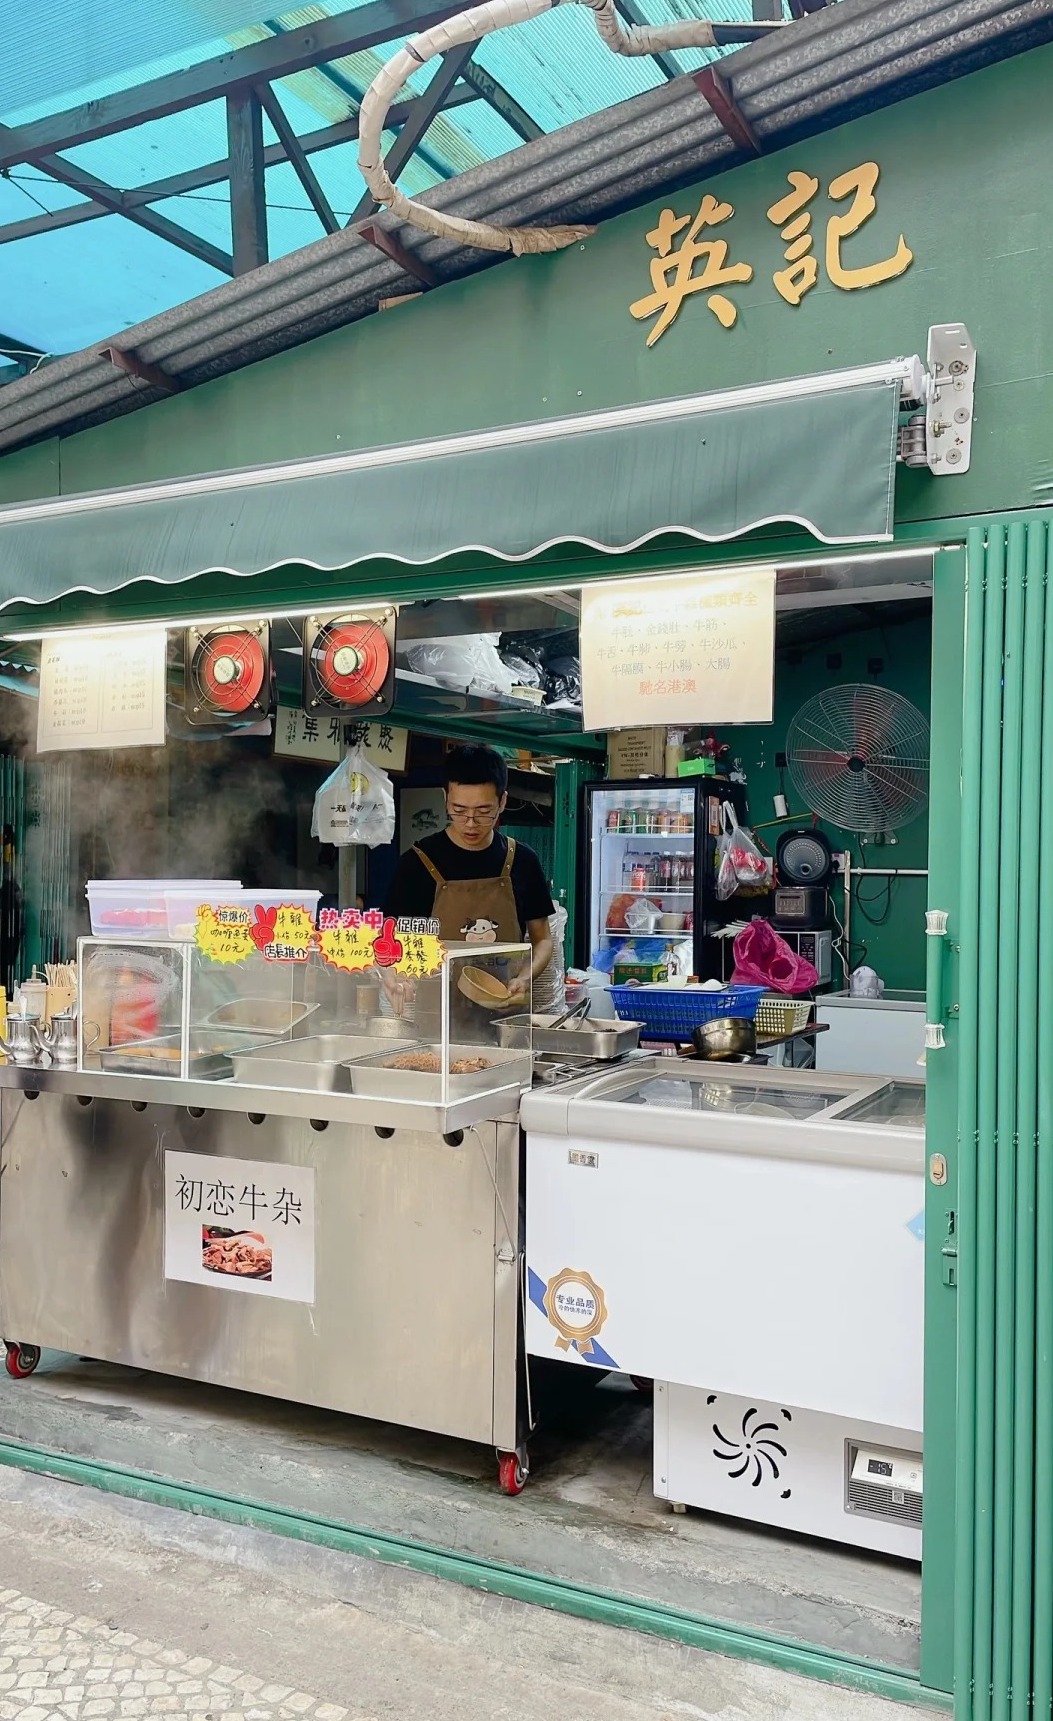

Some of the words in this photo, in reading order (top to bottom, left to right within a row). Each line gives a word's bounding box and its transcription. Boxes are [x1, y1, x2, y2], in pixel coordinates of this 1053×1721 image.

[629, 161, 913, 348] 英記
[639, 680, 696, 696] 馳名港澳
[219, 911, 248, 923] 惊爆价
[320, 909, 382, 930] 热卖中
[398, 917, 439, 934] 促销价
[220, 943, 244, 953] 10元
[264, 944, 307, 959] 店長推介
[350, 947, 373, 958] 100元
[406, 964, 428, 973] 60元
[175, 1173, 302, 1225] 初恋牛杂
[556, 1294, 594, 1309] 专业品质
